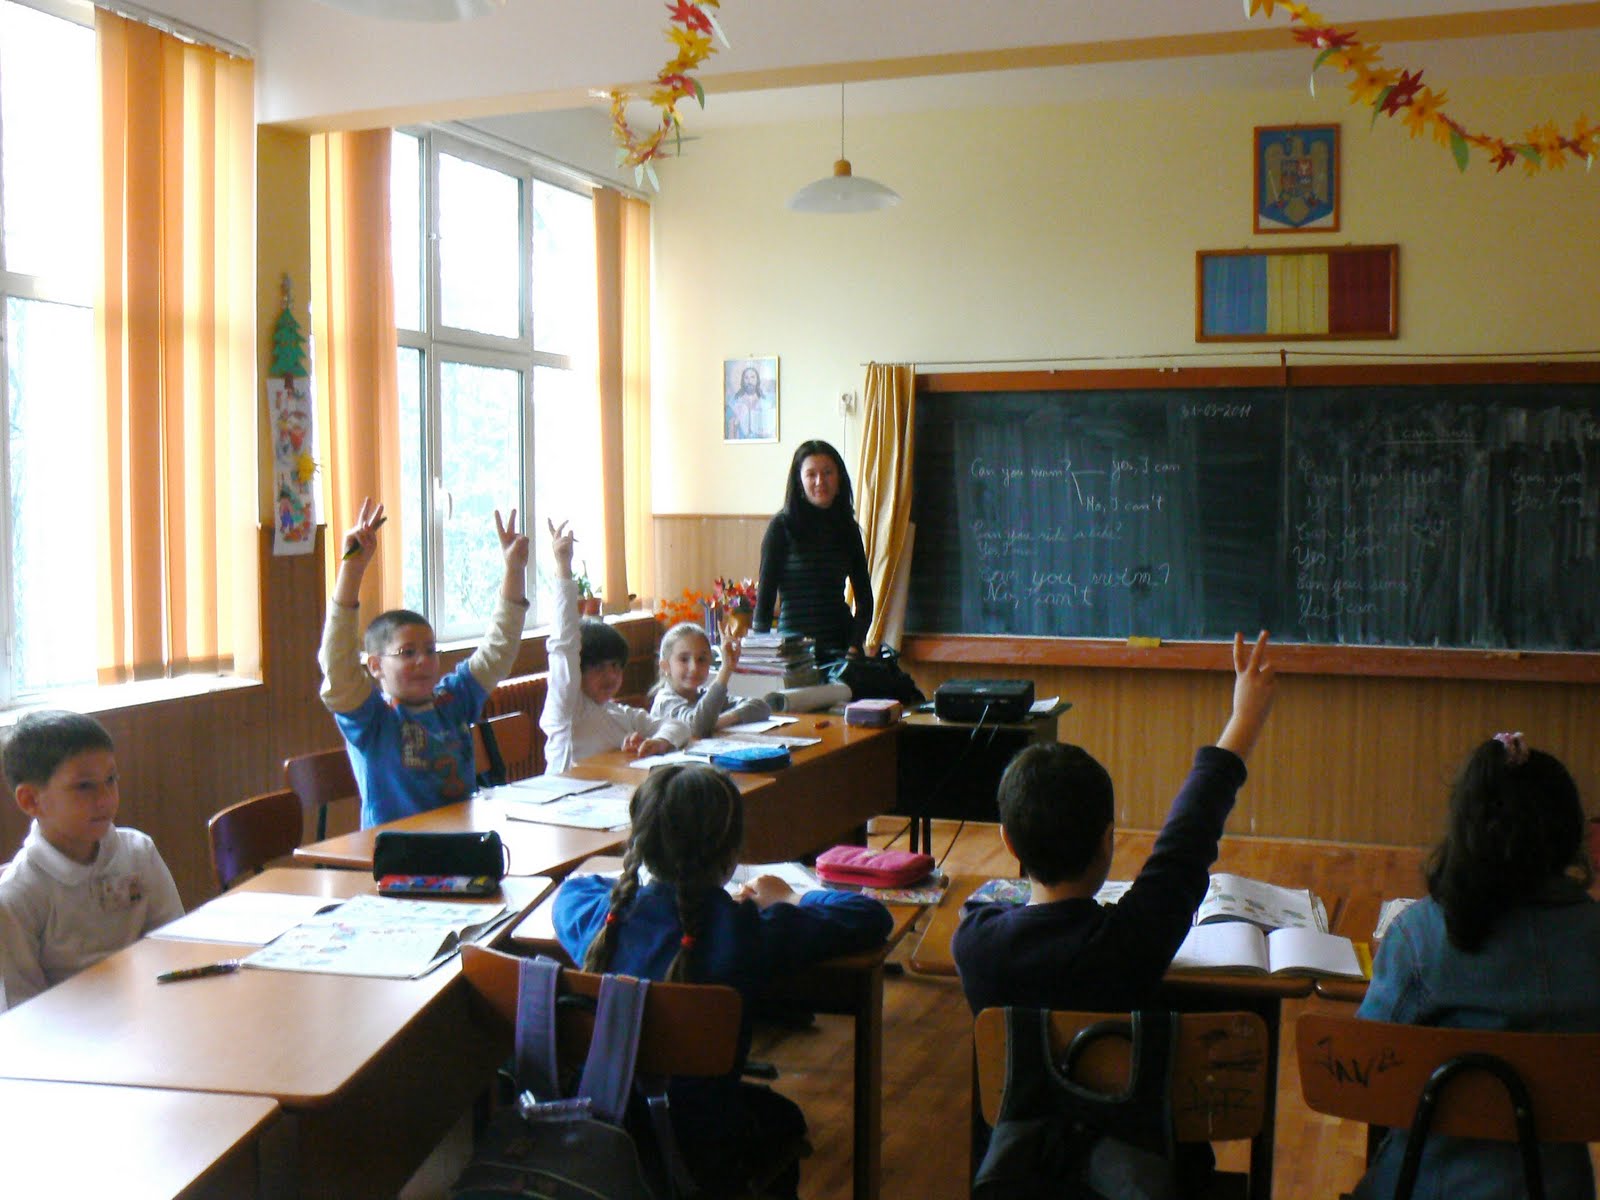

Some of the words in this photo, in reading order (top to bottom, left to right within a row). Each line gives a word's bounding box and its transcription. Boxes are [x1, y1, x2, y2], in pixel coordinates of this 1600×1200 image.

[971, 457, 995, 477] Can
[1001, 468, 1024, 487] you
[1031, 571, 1075, 593] you
